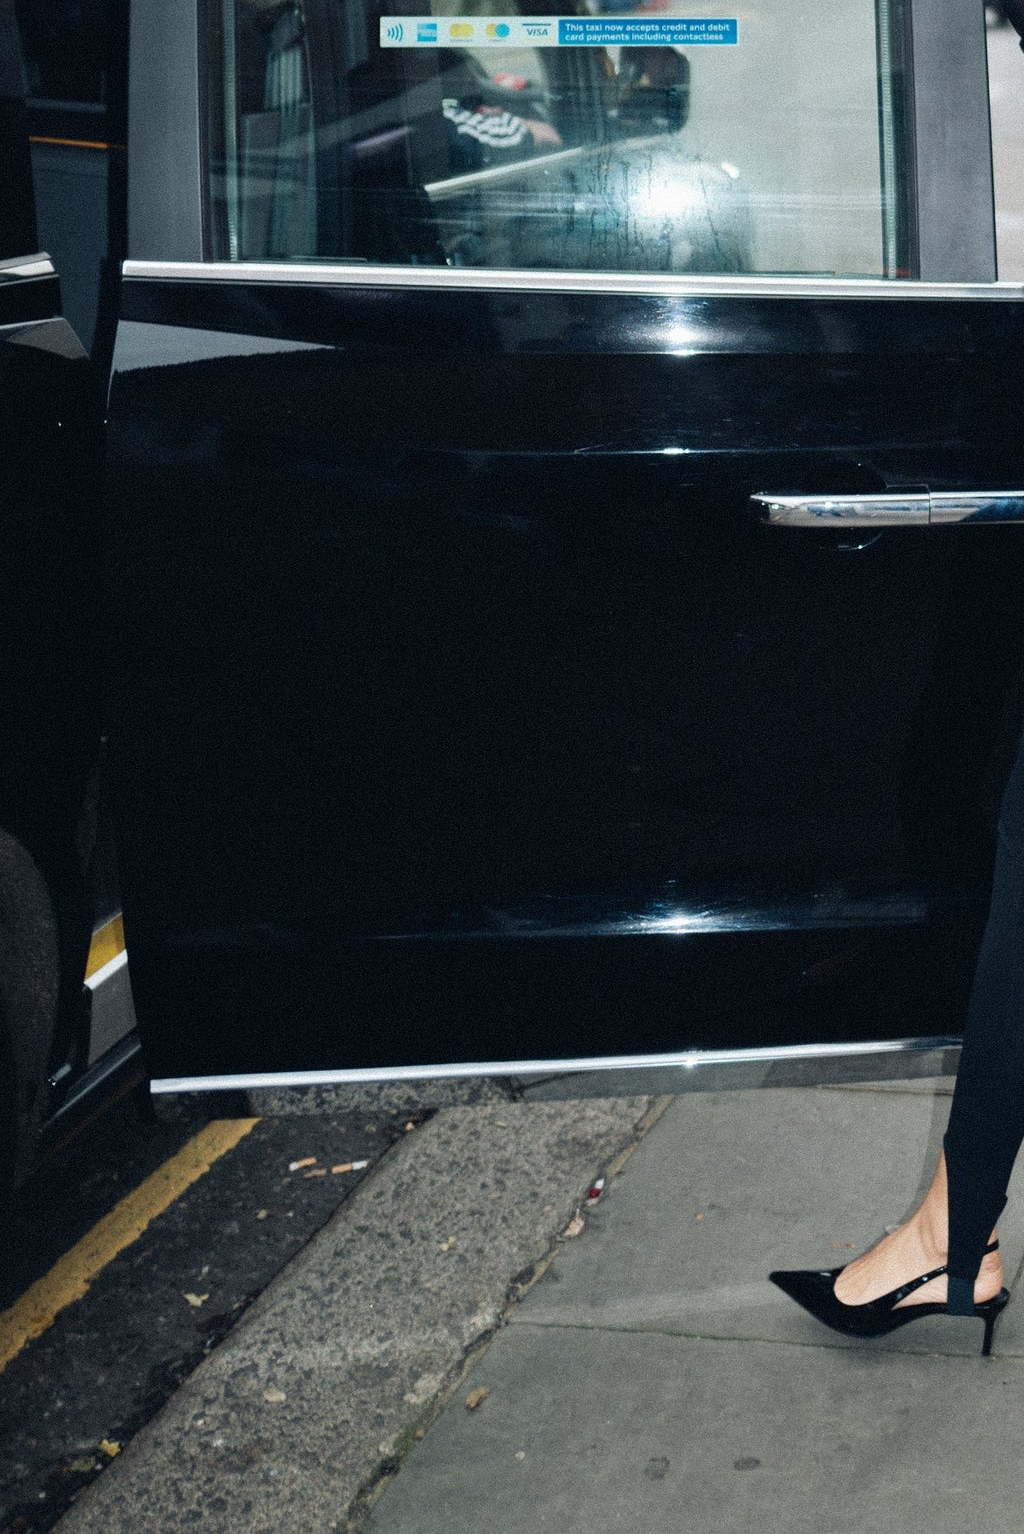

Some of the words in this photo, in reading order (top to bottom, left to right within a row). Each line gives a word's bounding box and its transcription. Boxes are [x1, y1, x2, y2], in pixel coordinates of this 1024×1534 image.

[526, 28, 549, 37] VISA
[565, 23, 584, 32] This
[585, 23, 603, 32] taxi
[625, 24, 660, 34] accepts
[661, 23, 687, 32] credit
[689, 23, 706, 32] and
[707, 23, 730, 32] debit
[565, 33, 584, 42] card
[586, 33, 630, 43] payments
[631, 32, 671, 43] including
[673, 32, 724, 41] contactless
